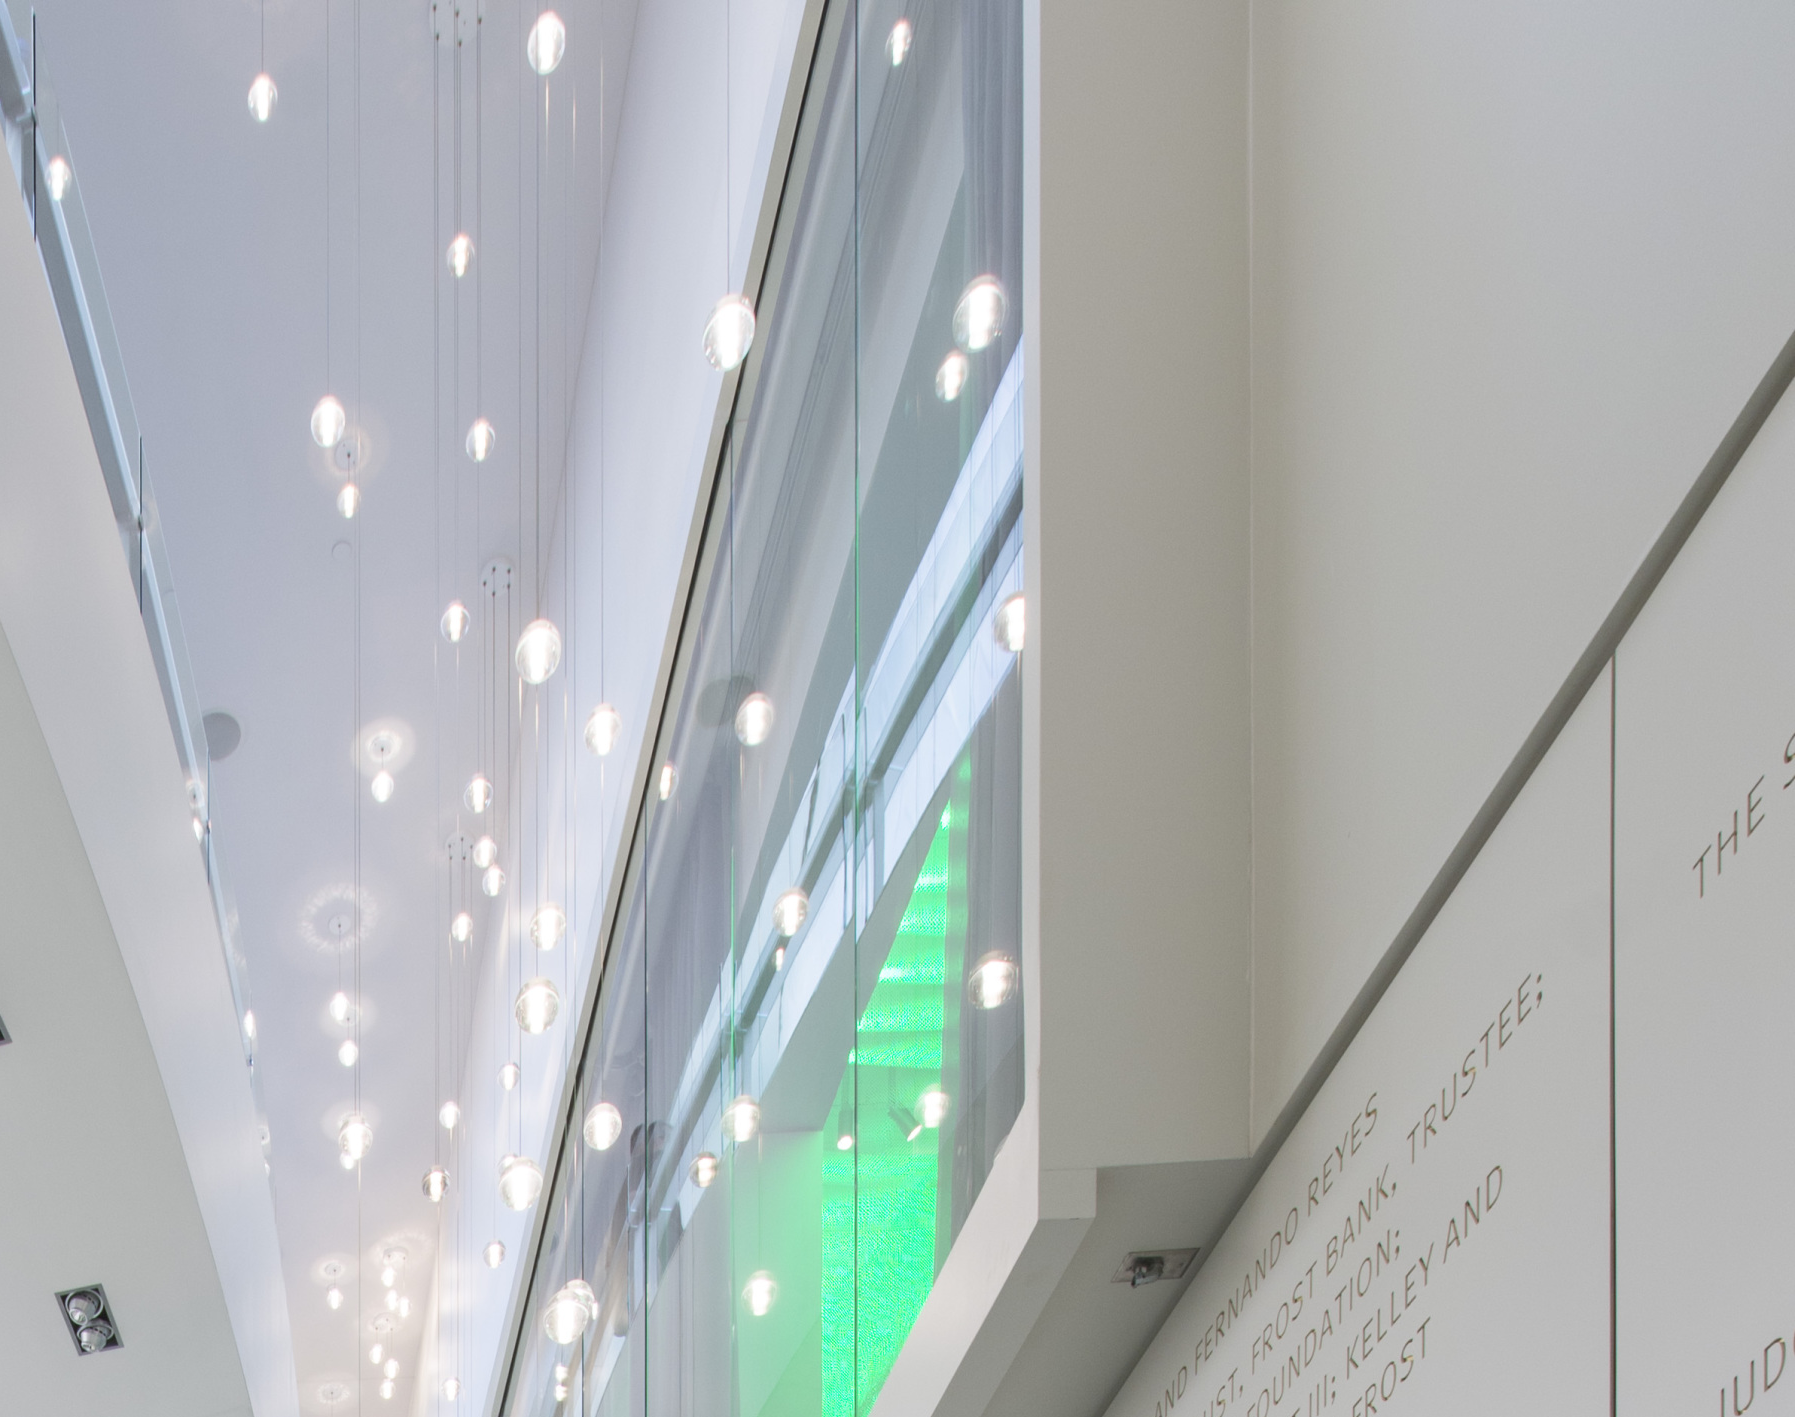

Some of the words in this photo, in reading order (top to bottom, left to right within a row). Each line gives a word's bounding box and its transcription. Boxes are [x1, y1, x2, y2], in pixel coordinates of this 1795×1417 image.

[1692, 774, 1766, 899] THE
[1194, 1205, 1299, 1376] FERNANDO
[1306, 1090, 1378, 1218] REYES
[1251, 1258, 1318, 1376] FROST
[1325, 1161, 1397, 1278] BANK,
[1405, 971, 1543, 1165] TRUSTEE;
[1345, 1240, 1434, 1380] KELLEY
[1442, 1162, 1503, 1265] AND
